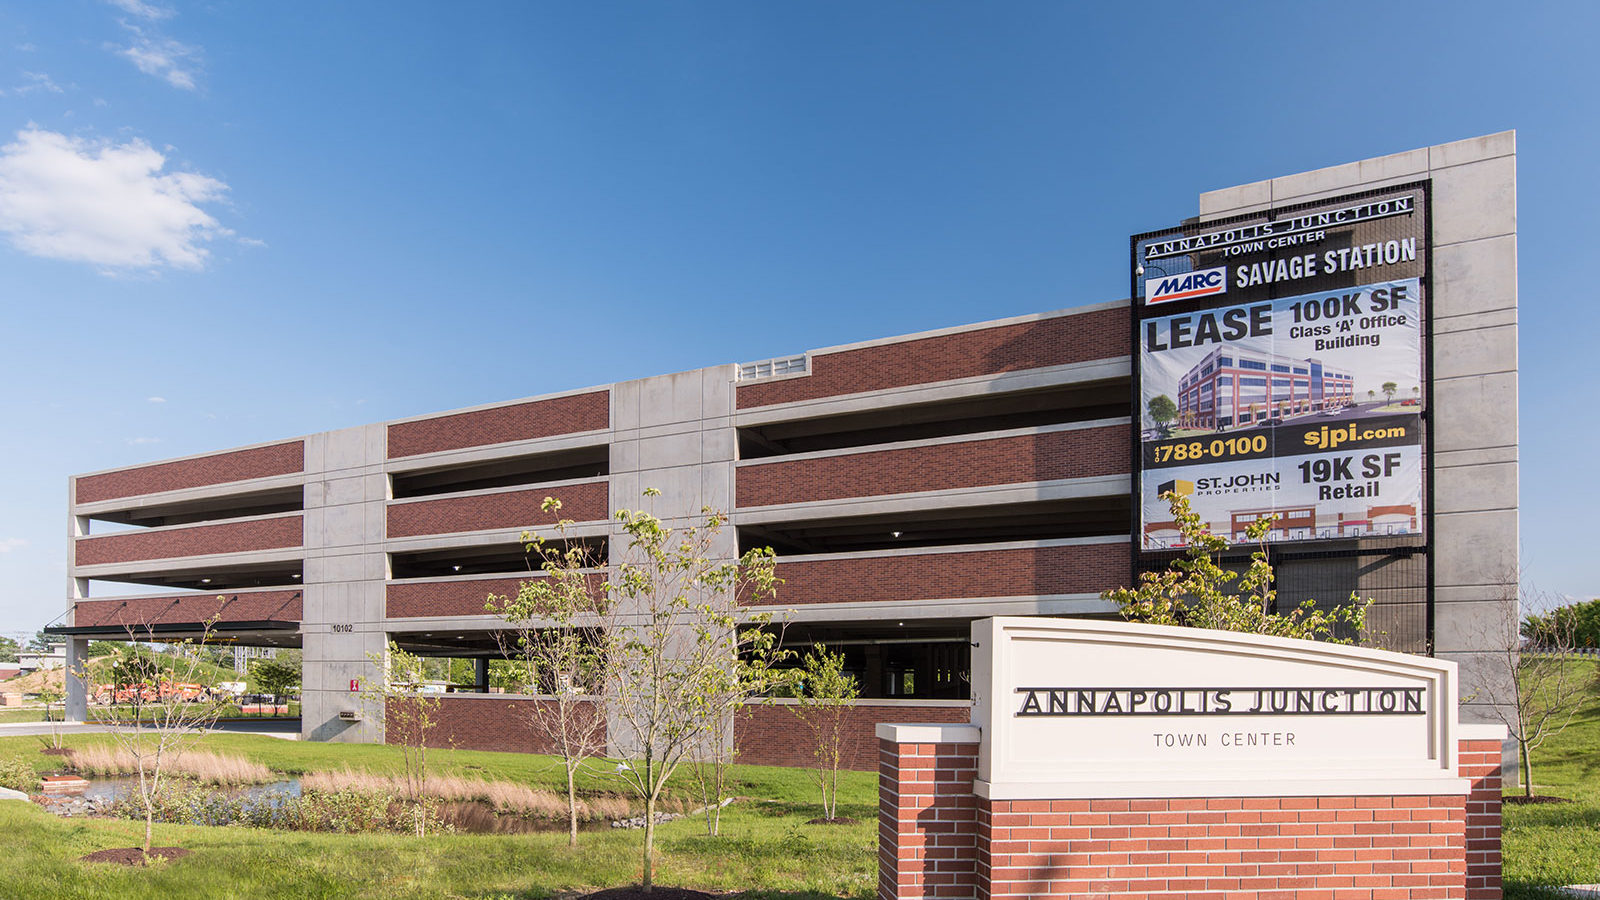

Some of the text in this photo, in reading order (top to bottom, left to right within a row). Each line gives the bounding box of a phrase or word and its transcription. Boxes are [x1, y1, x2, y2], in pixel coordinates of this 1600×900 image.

[1149, 199, 1409, 256] ANNAPOLIS JUNCTION
[1223, 231, 1326, 257] TOWN CENTER
[1236, 237, 1416, 289] SAVAGE STATION
[1154, 271, 1222, 296] MARC
[1289, 286, 1407, 323] 100K SF
[1148, 304, 1273, 352] LEASE
[1290, 322, 1331, 339] Class
[1360, 314, 1407, 329] Office
[1315, 333, 1380, 351] Building
[1160, 435, 1267, 462] 788-0100
[1303, 423, 1406, 449] sjpi.com
[1298, 453, 1401, 484] 19K SF
[1198, 485, 1280, 496] PROPERTIES
[1319, 481, 1379, 500] Retail
[333, 624, 353, 633] 10102
[1022, 690, 1424, 713] ANNAPOLIS JUNCTION
[1153, 732, 1296, 747] TOWN CENTER
